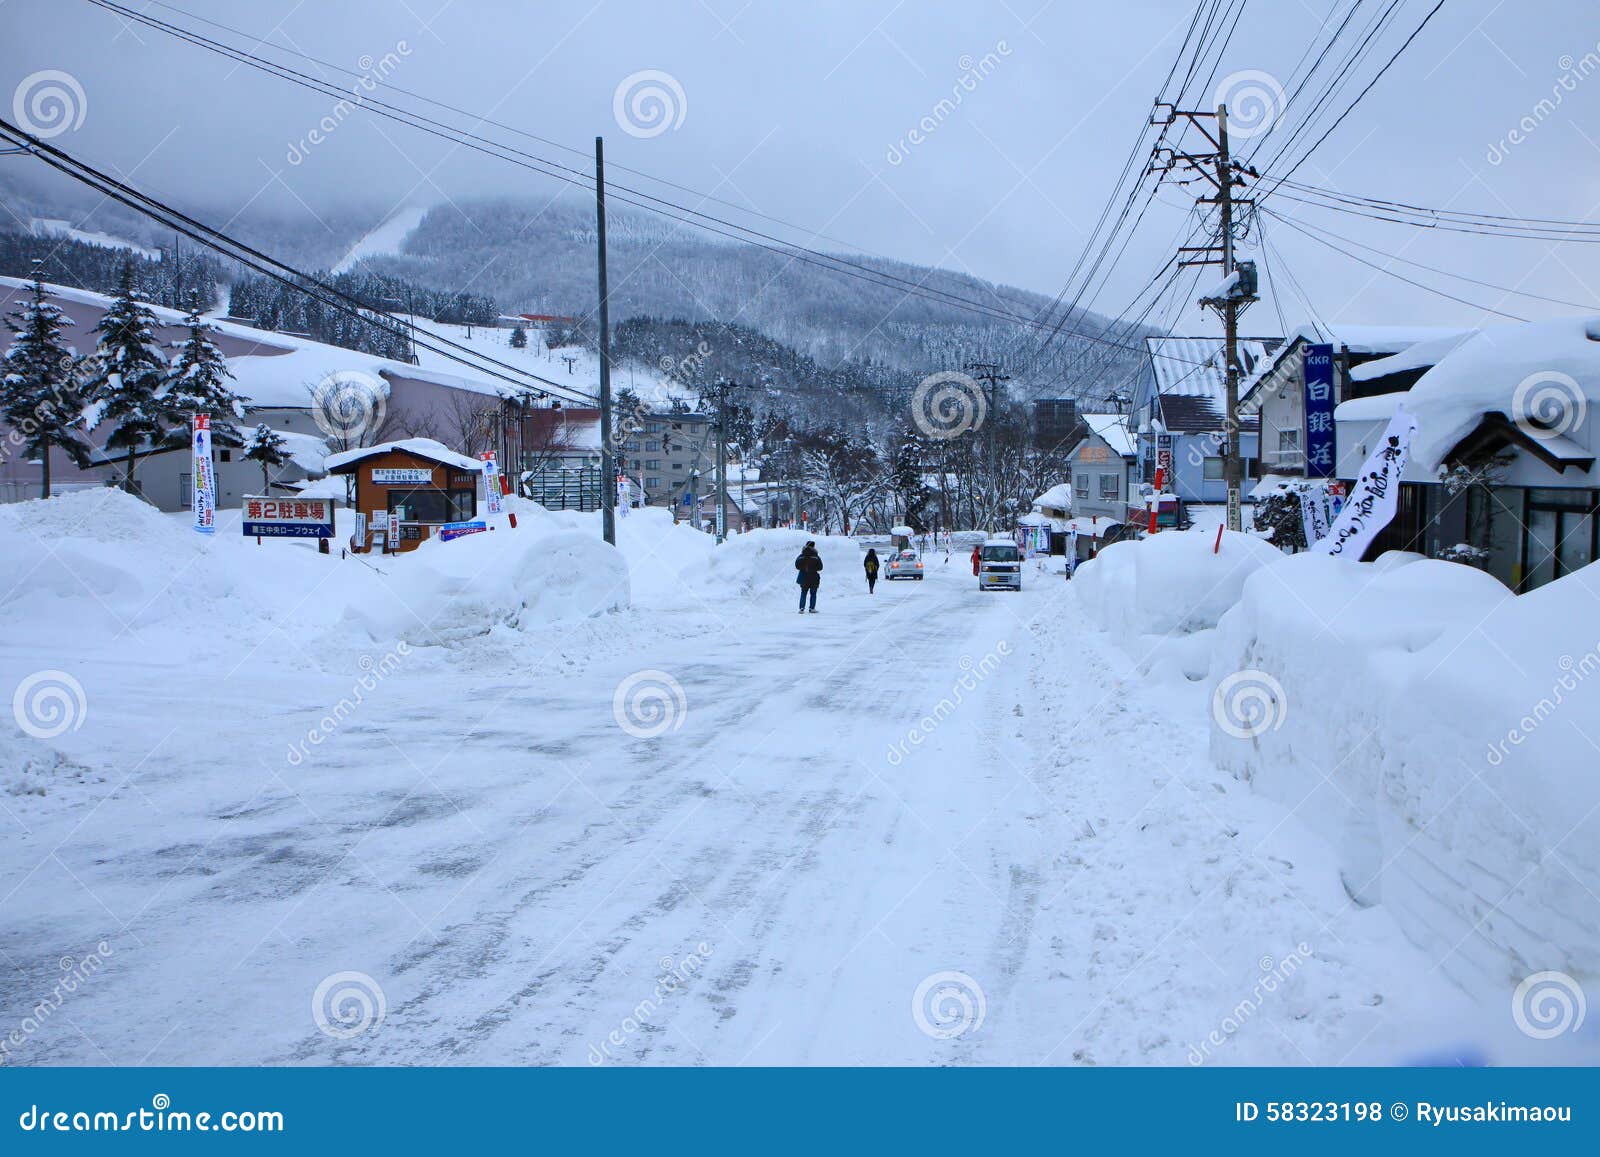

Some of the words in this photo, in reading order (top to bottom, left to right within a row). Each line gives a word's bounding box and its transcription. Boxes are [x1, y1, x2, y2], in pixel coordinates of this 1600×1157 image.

[1307, 356, 1329, 365] KKR
[248, 501, 325, 520] 第2駐車場
